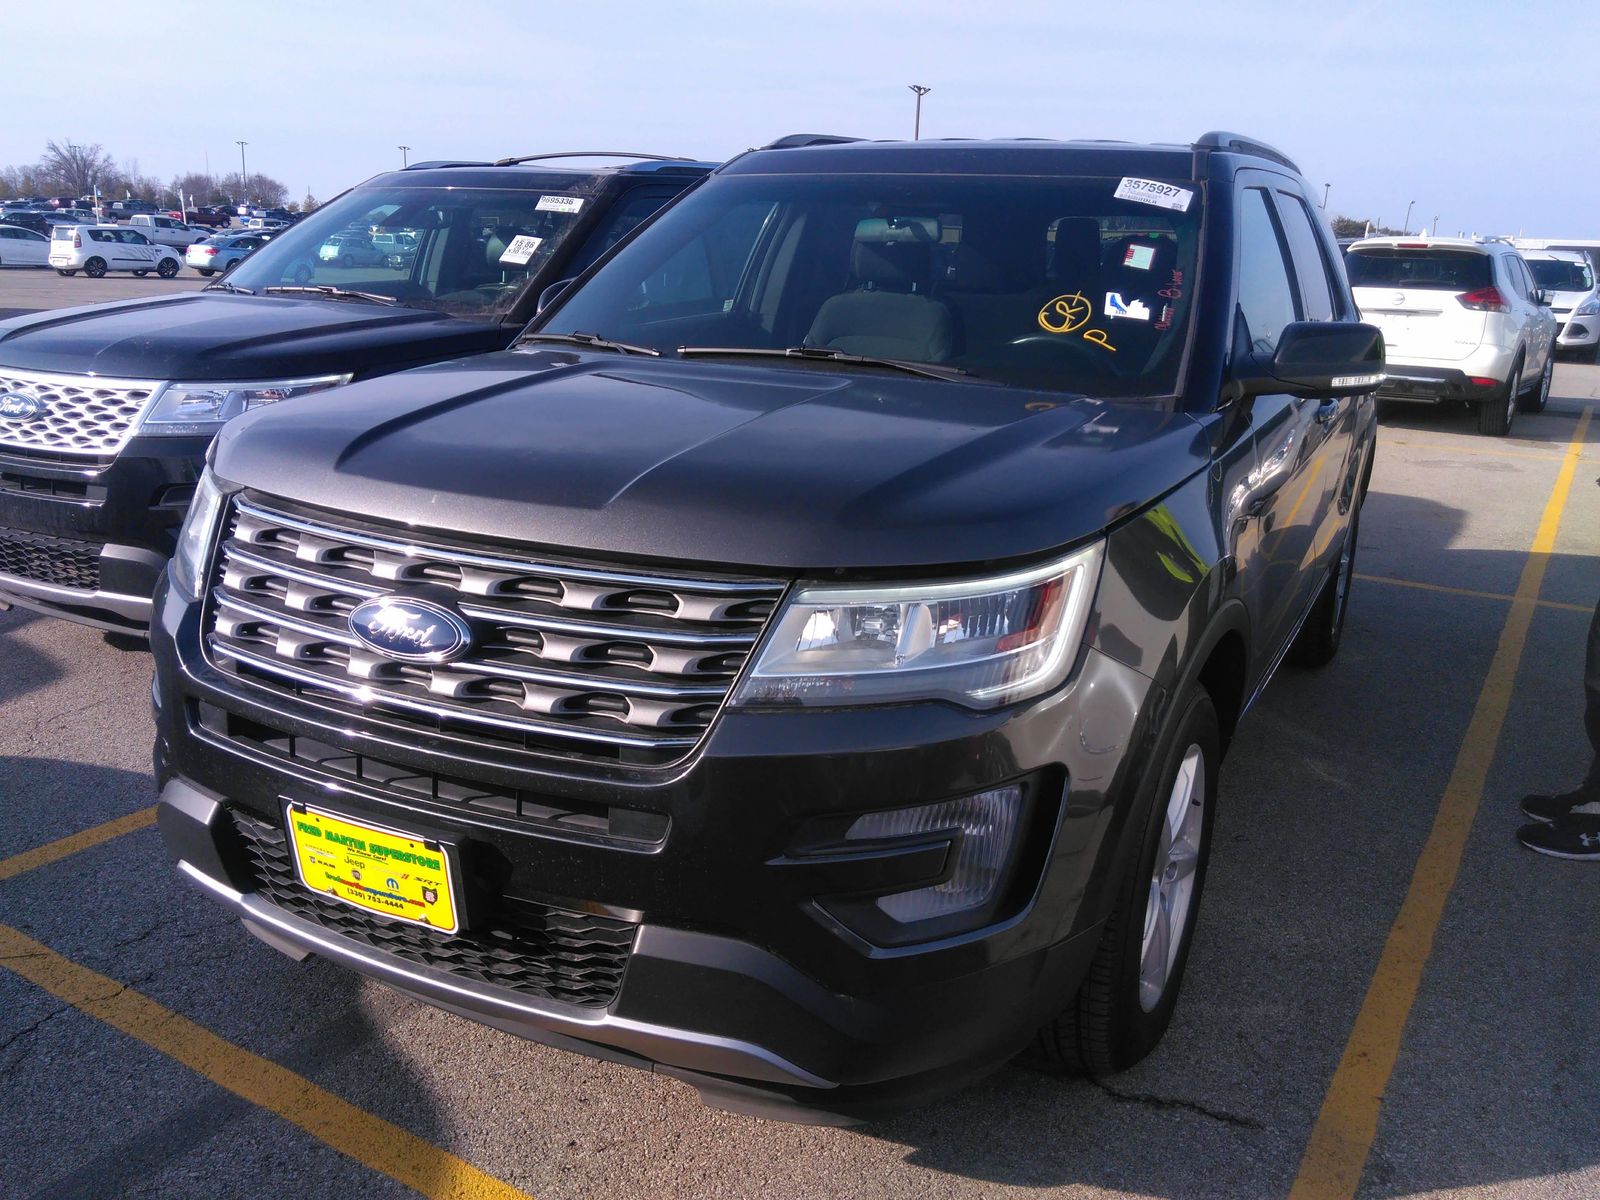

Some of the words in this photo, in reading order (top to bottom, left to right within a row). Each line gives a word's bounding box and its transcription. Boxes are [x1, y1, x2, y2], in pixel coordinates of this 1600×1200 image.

[1123, 178, 1182, 198] 3575927
[367, 605, 437, 648] Ford
[296, 821, 323, 838] FRED
[325, 830, 367, 852] MARTIN
[369, 842, 441, 871] SUPERSTORE
[344, 855, 365, 870] Jeep
